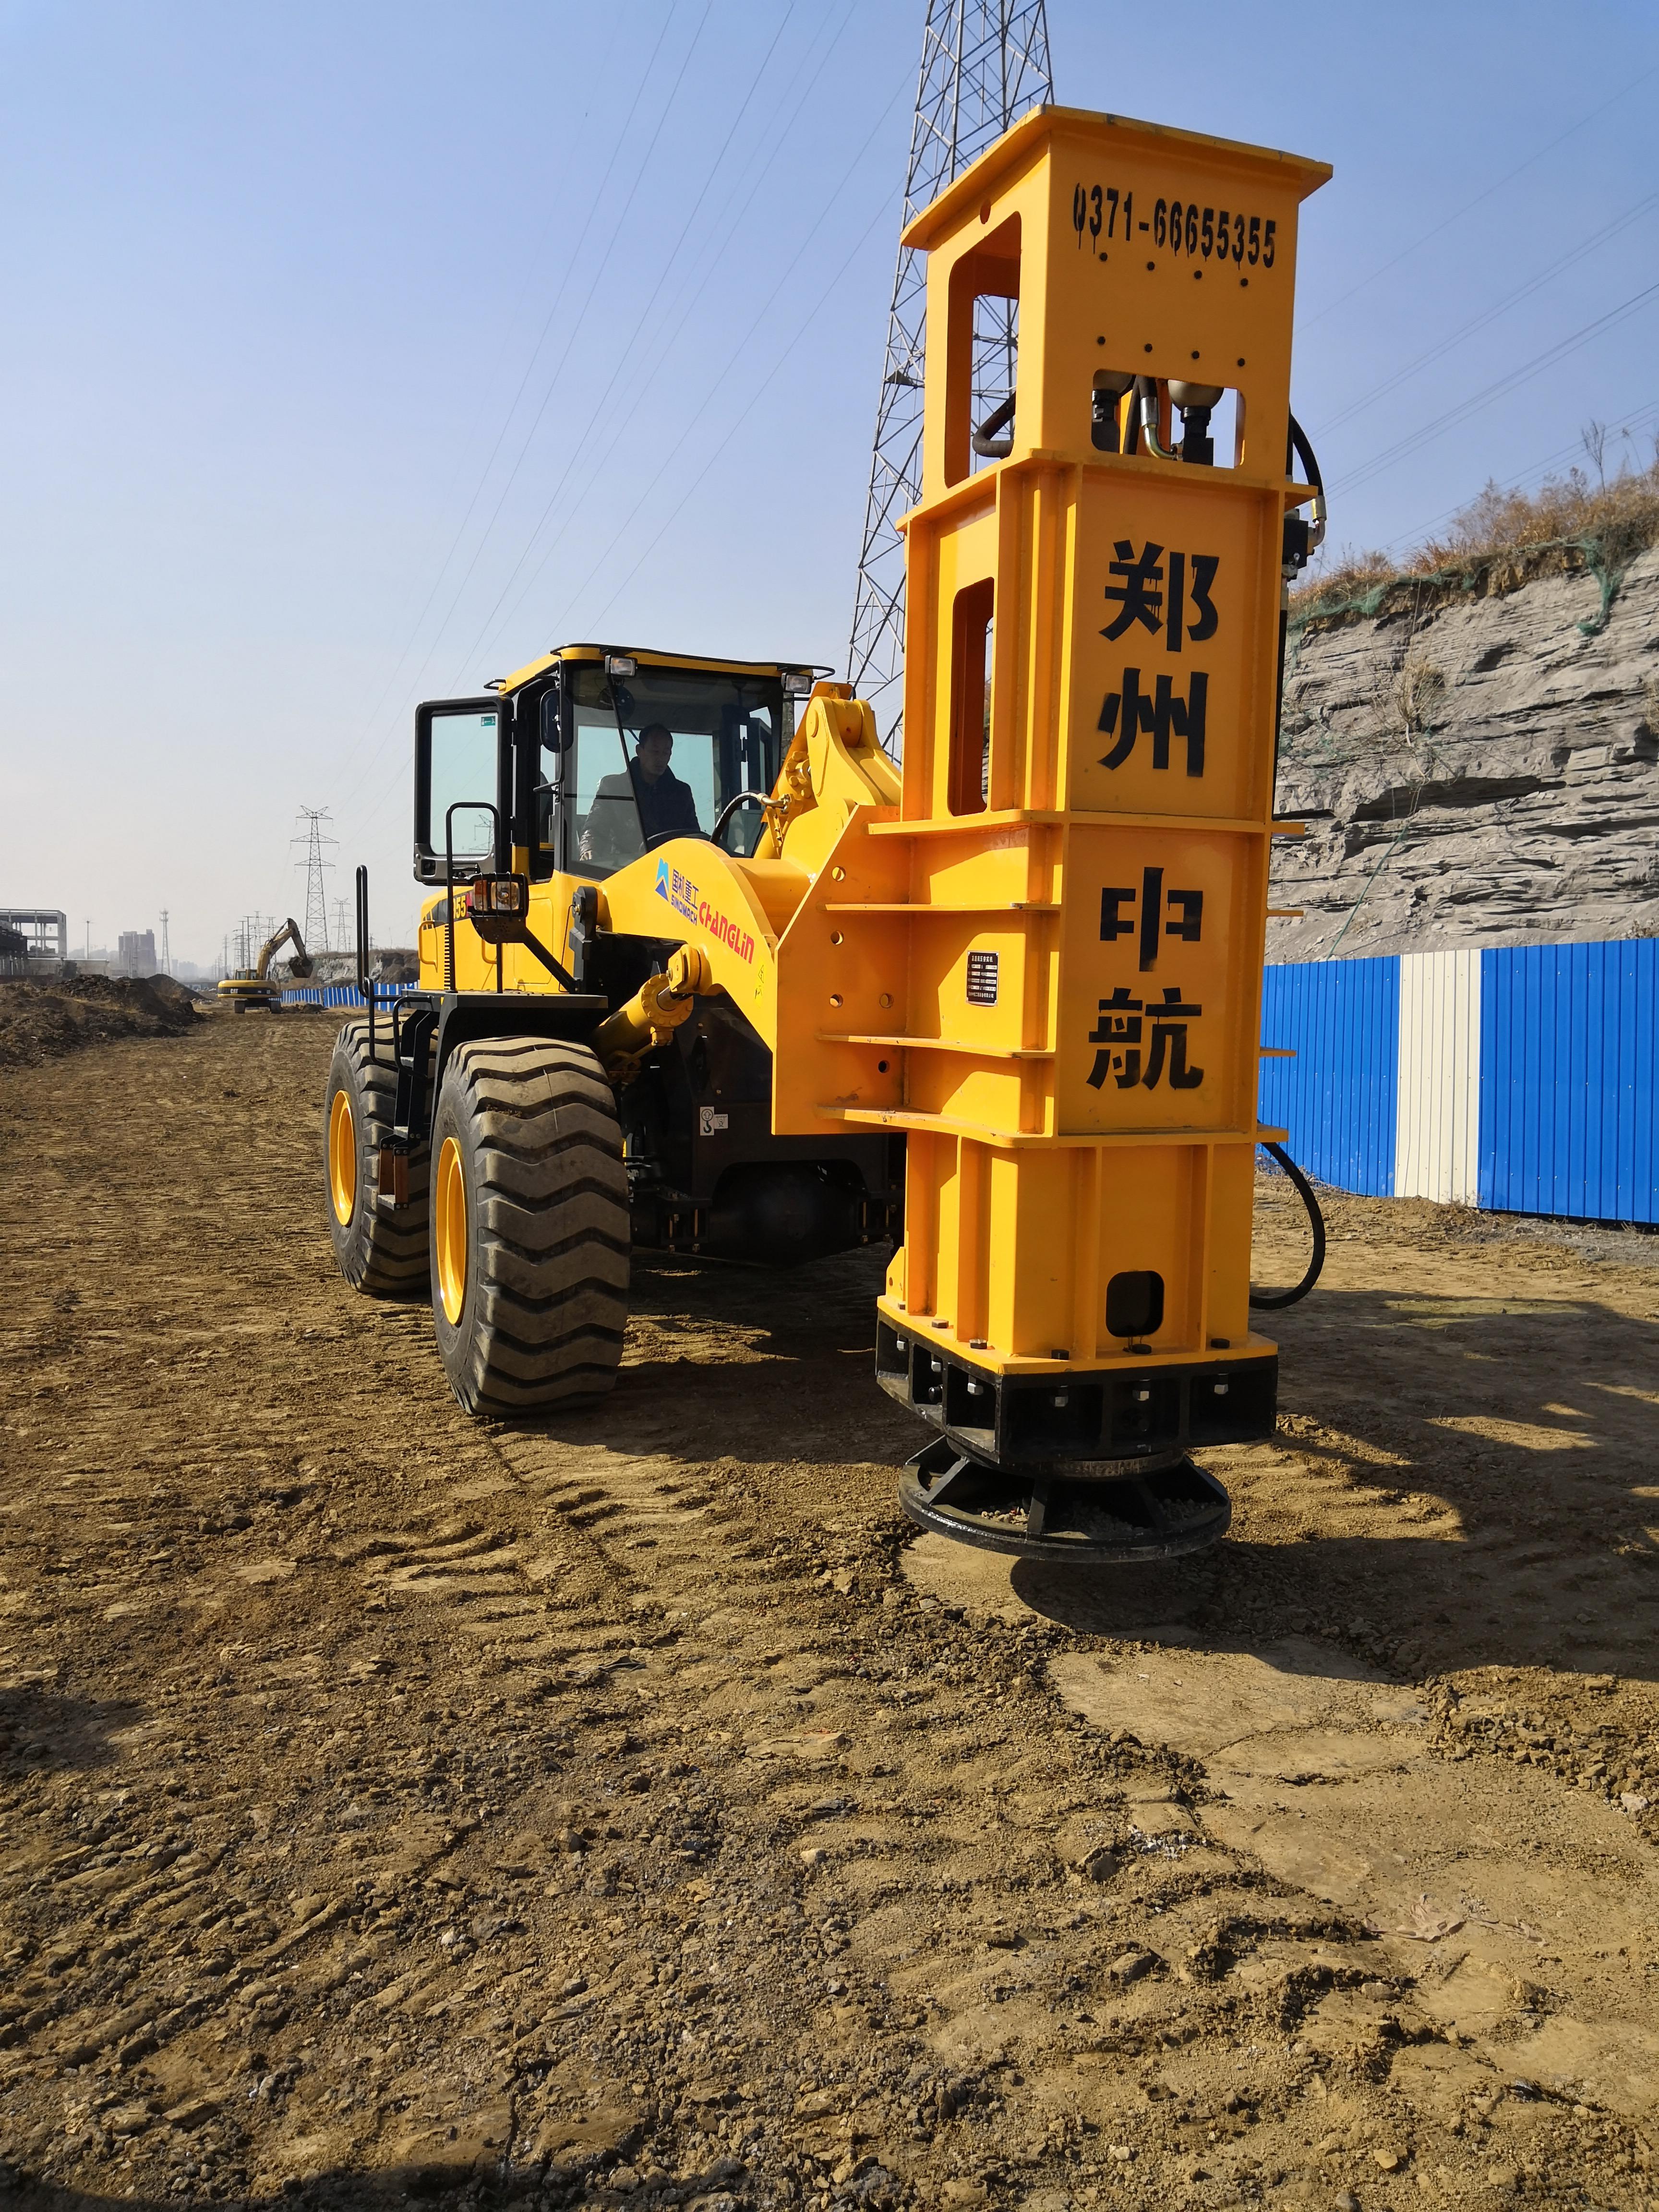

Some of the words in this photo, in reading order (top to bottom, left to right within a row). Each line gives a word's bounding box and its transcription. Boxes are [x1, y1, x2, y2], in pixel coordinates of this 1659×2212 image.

[1073, 183, 1276, 268] 0371-66655355
[671, 894, 697, 926] SINOMACH
[672, 868, 699, 910] 国机重工
